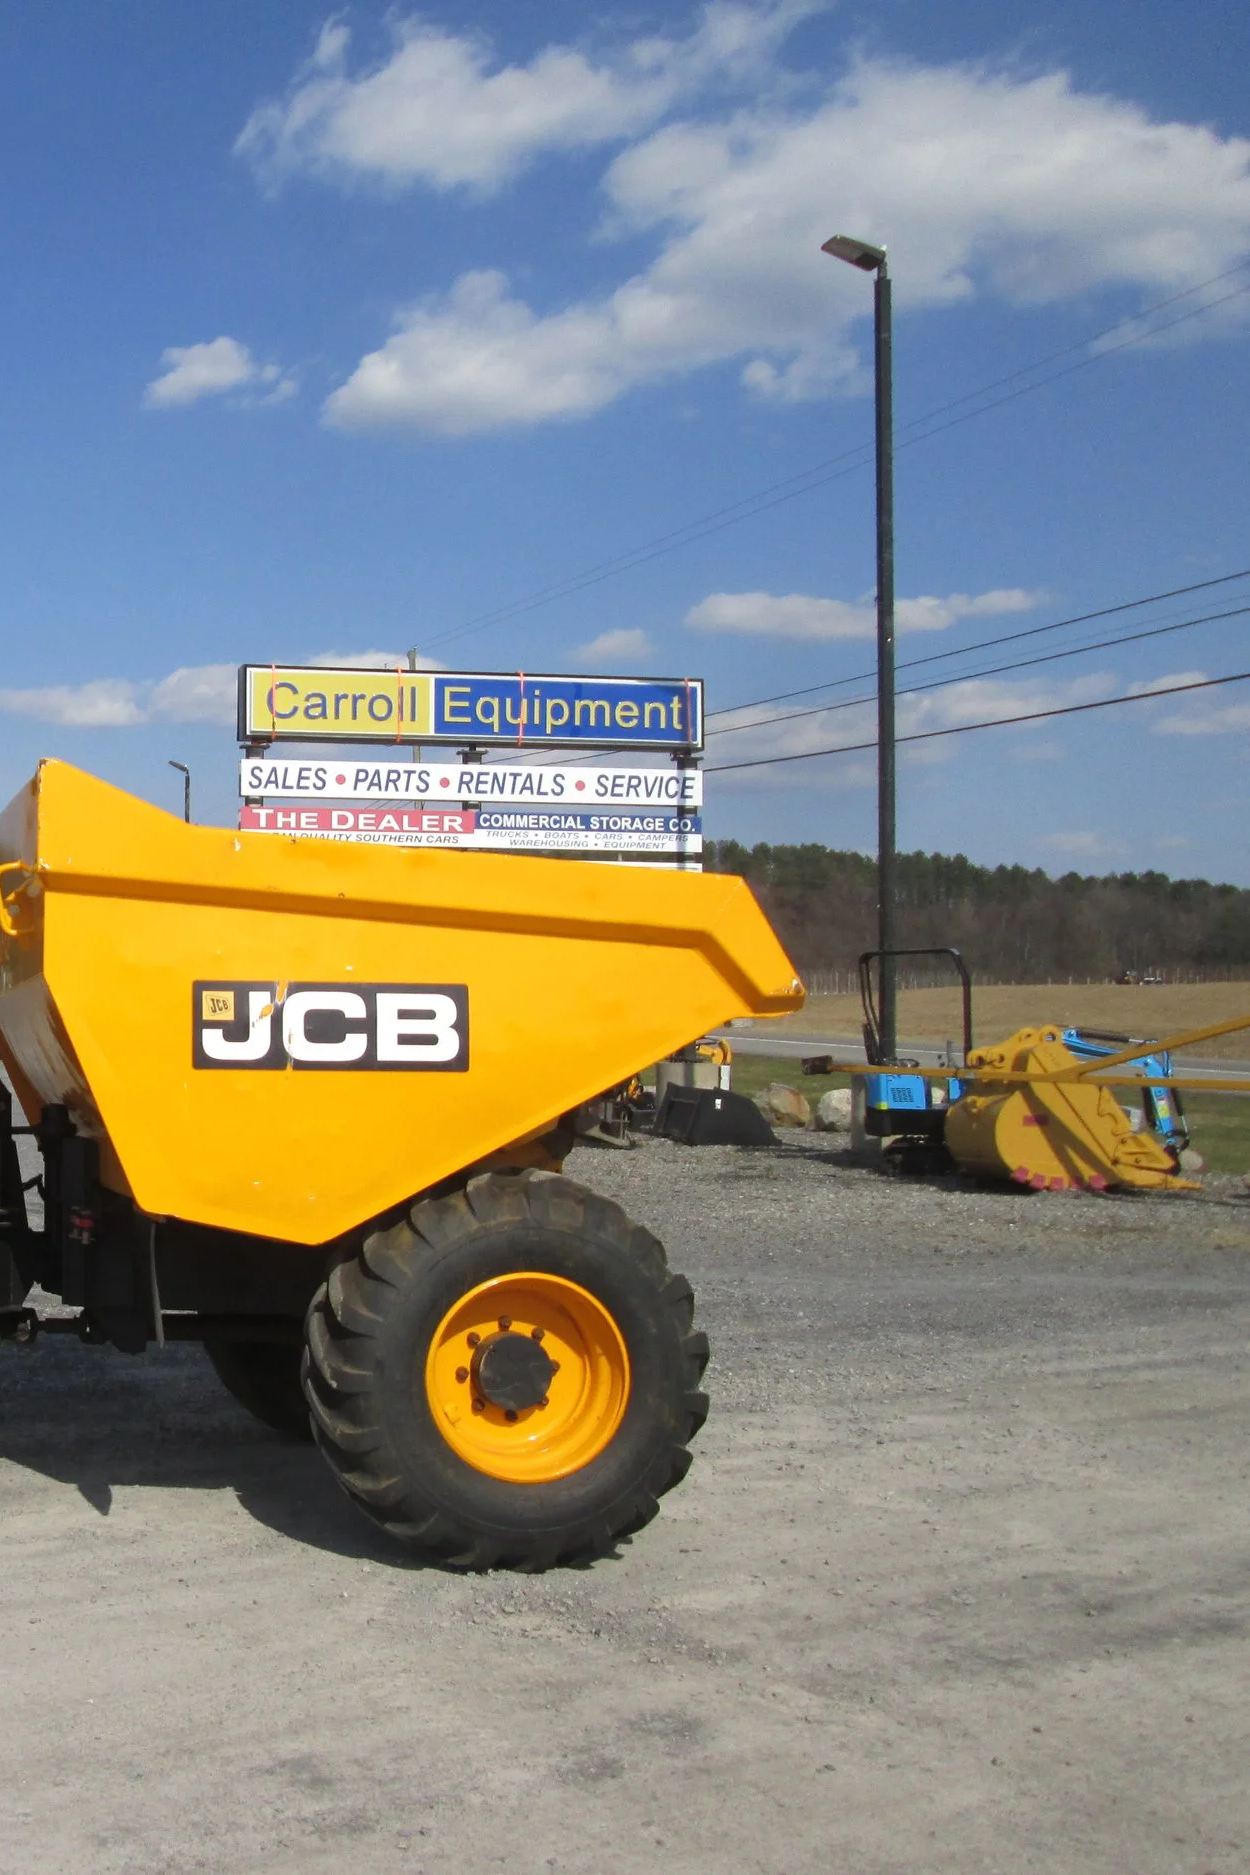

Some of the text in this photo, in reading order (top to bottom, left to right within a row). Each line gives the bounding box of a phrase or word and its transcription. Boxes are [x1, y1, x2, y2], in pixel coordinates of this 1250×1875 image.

[266, 681, 683, 735] Carroll Equipment
[248, 765, 696, 799] SALES PARTS RENTALS SERVICE
[252, 808, 464, 832] THE DEALER
[479, 813, 696, 832] COMMERCIAL STORAGE CO.
[355, 833, 423, 843] SOUTHERN
[426, 835, 459, 844] CARS
[486, 830, 689, 843] TRUCKS BOATS CARS CAMPERS
[509, 838, 667, 850] WAREHOUSING EQUIPMENT
[210, 997, 229, 1014] JCB
[202, 991, 460, 1062] JCB
